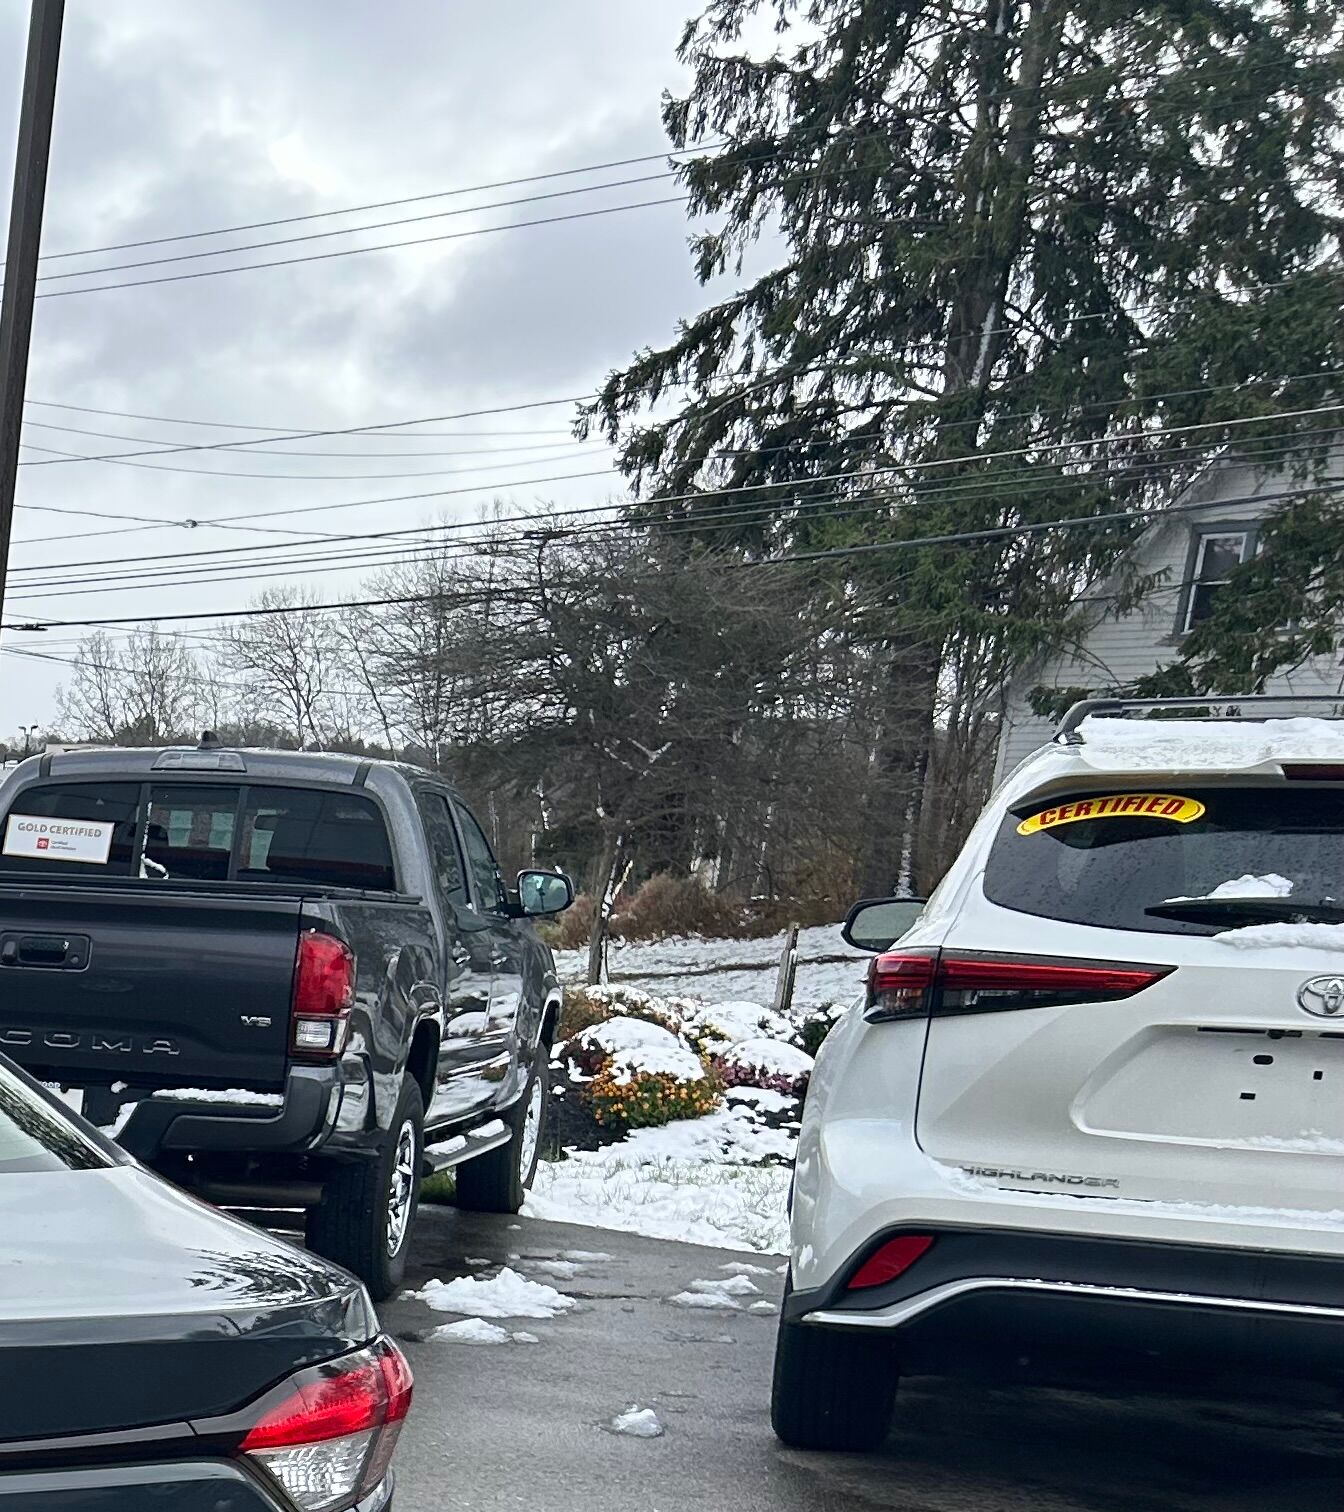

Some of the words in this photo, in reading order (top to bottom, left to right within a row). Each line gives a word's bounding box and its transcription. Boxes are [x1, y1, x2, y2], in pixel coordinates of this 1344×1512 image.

[1039, 796, 1186, 826] CERTIFIED
[18, 822, 47, 833] GOLD
[49, 825, 102, 838] CERTIFIED
[960, 1165, 1121, 1189] HIGHLANDER
